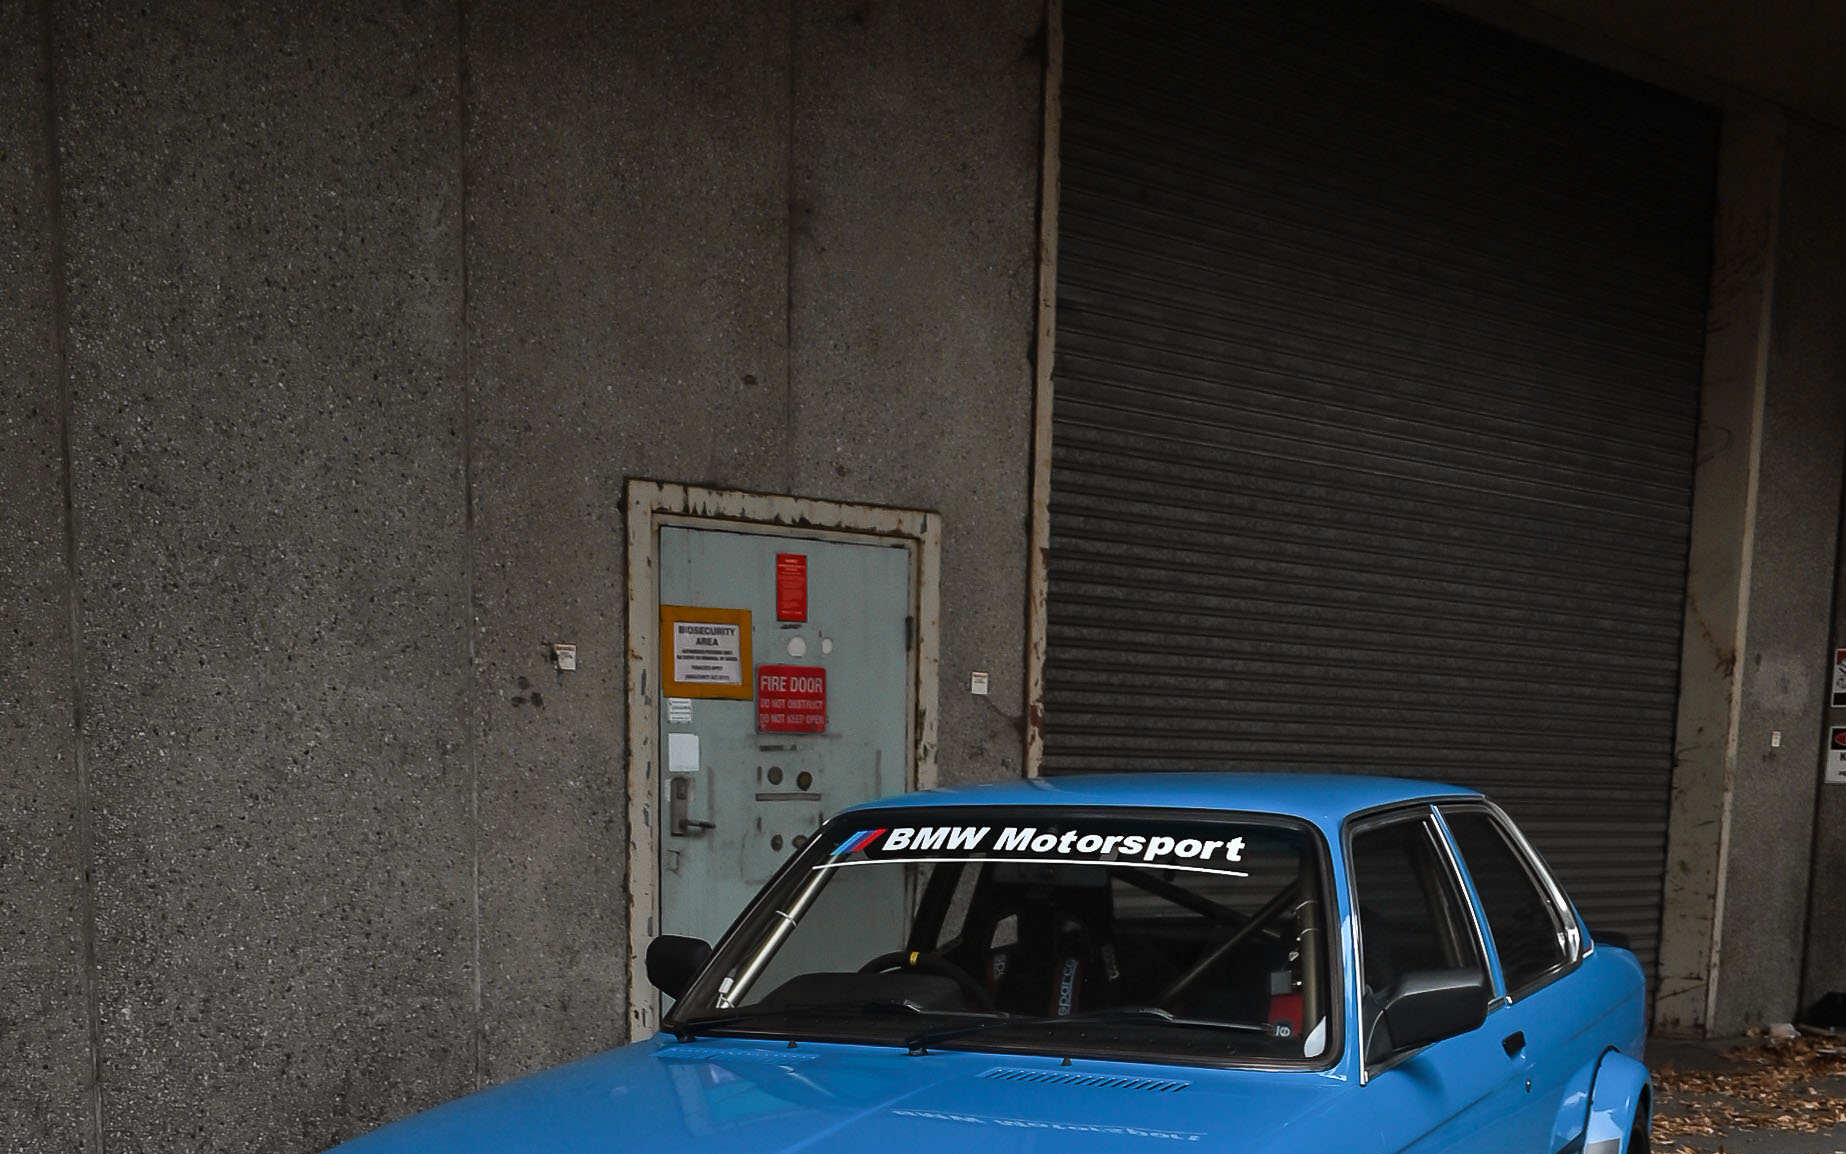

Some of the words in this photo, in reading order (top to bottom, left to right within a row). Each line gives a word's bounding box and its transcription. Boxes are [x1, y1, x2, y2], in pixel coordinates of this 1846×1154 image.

[678, 625, 736, 636] BIOSECURITY
[695, 637, 719, 646] AREA
[760, 675, 787, 692] FIRE
[790, 676, 823, 693] DOOR
[882, 827, 991, 851] BMW
[993, 827, 1247, 862] Motorsport
